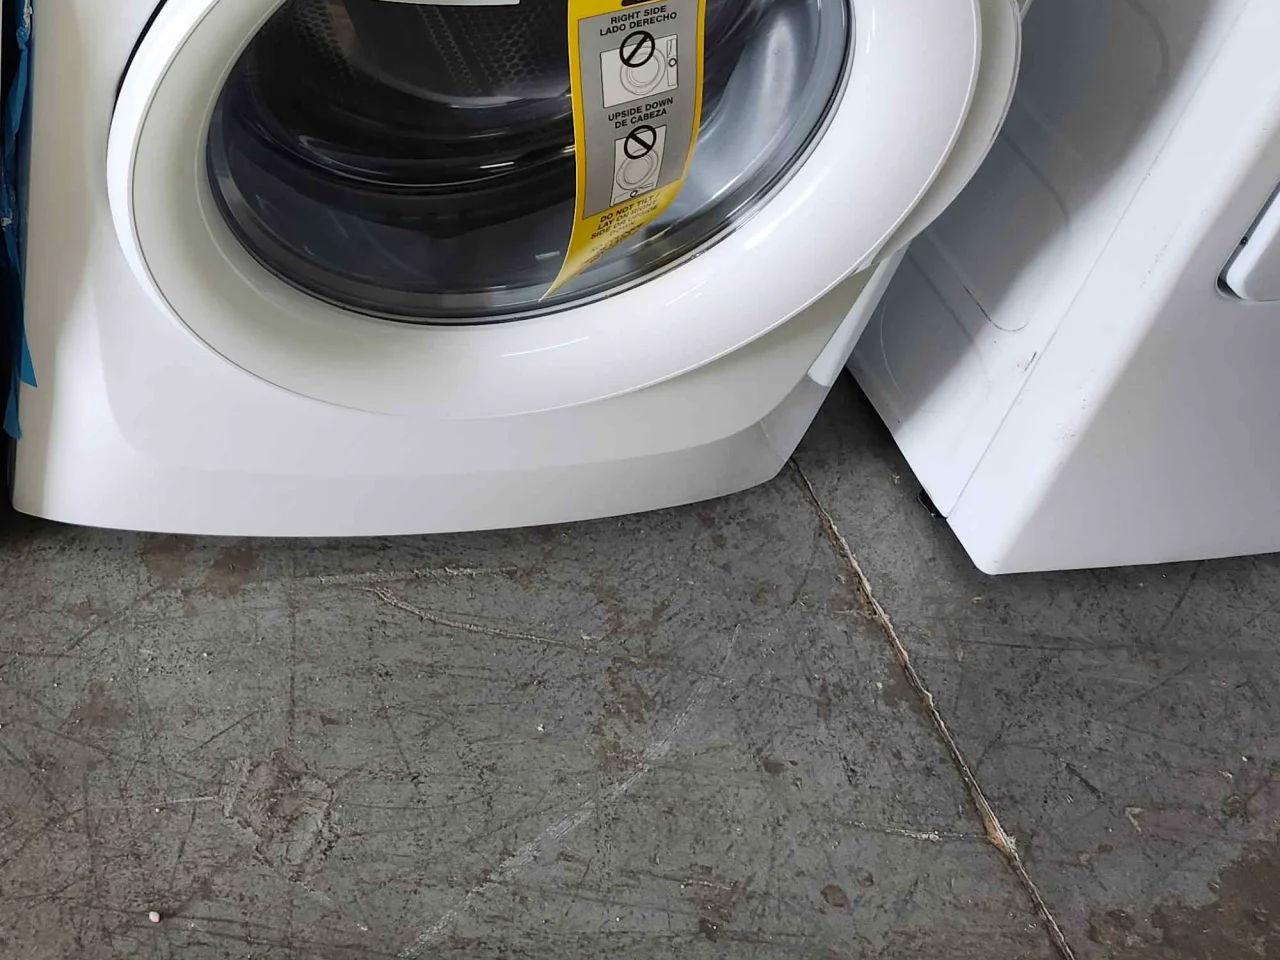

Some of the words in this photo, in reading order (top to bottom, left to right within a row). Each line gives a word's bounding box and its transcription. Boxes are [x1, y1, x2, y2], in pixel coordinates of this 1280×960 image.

[600, 23, 626, 36] LADO
[629, 12, 677, 29] DERECHO
[610, 11, 640, 24] RIGHT
[644, 5, 667, 17] SIDE
[608, 106, 642, 121] UPSIDE
[645, 97, 674, 112] DOWN
[615, 120, 628, 128] DE
[630, 108, 667, 124] CABEZA
[600, 213, 613, 222] DO
[615, 203, 633, 215] NOT
[590, 227, 612, 239] SIDE
[598, 220, 613, 230] LAY
